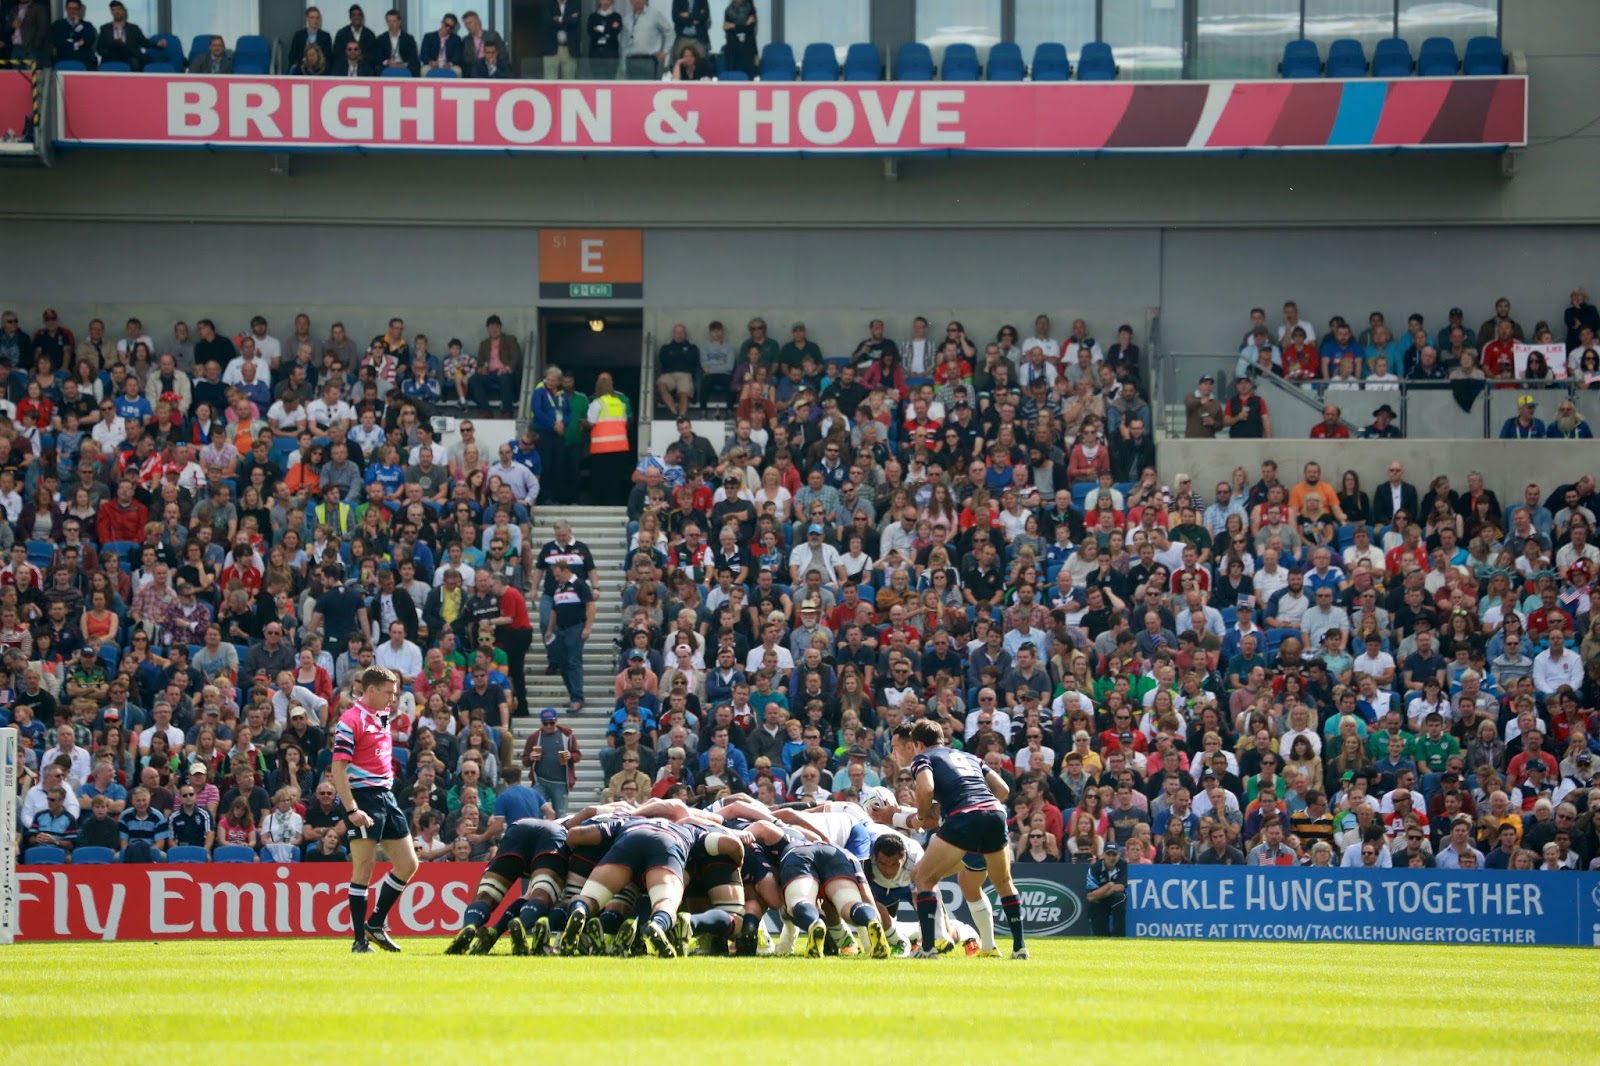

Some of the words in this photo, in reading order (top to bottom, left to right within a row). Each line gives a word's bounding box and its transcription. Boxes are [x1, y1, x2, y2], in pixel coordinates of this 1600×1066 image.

[166, 82, 612, 146] BRIGHTON
[644, 88, 705, 145] &
[738, 89, 966, 145] HOVE
[581, 239, 604, 272] E
[590, 286, 608, 295] Exit
[14, 872, 126, 940] Fly
[995, 891, 1046, 906] LND
[1128, 879, 1235, 910] TACKLE
[1246, 874, 1375, 912] HUNGER
[1381, 881, 1544, 916] TOGETHER
[1136, 923, 1203, 937] DONATE
[1208, 924, 1229, 938] AT
[1233, 923, 1536, 943] ITV.COM/TACKLEHUNGERTOGETHER
